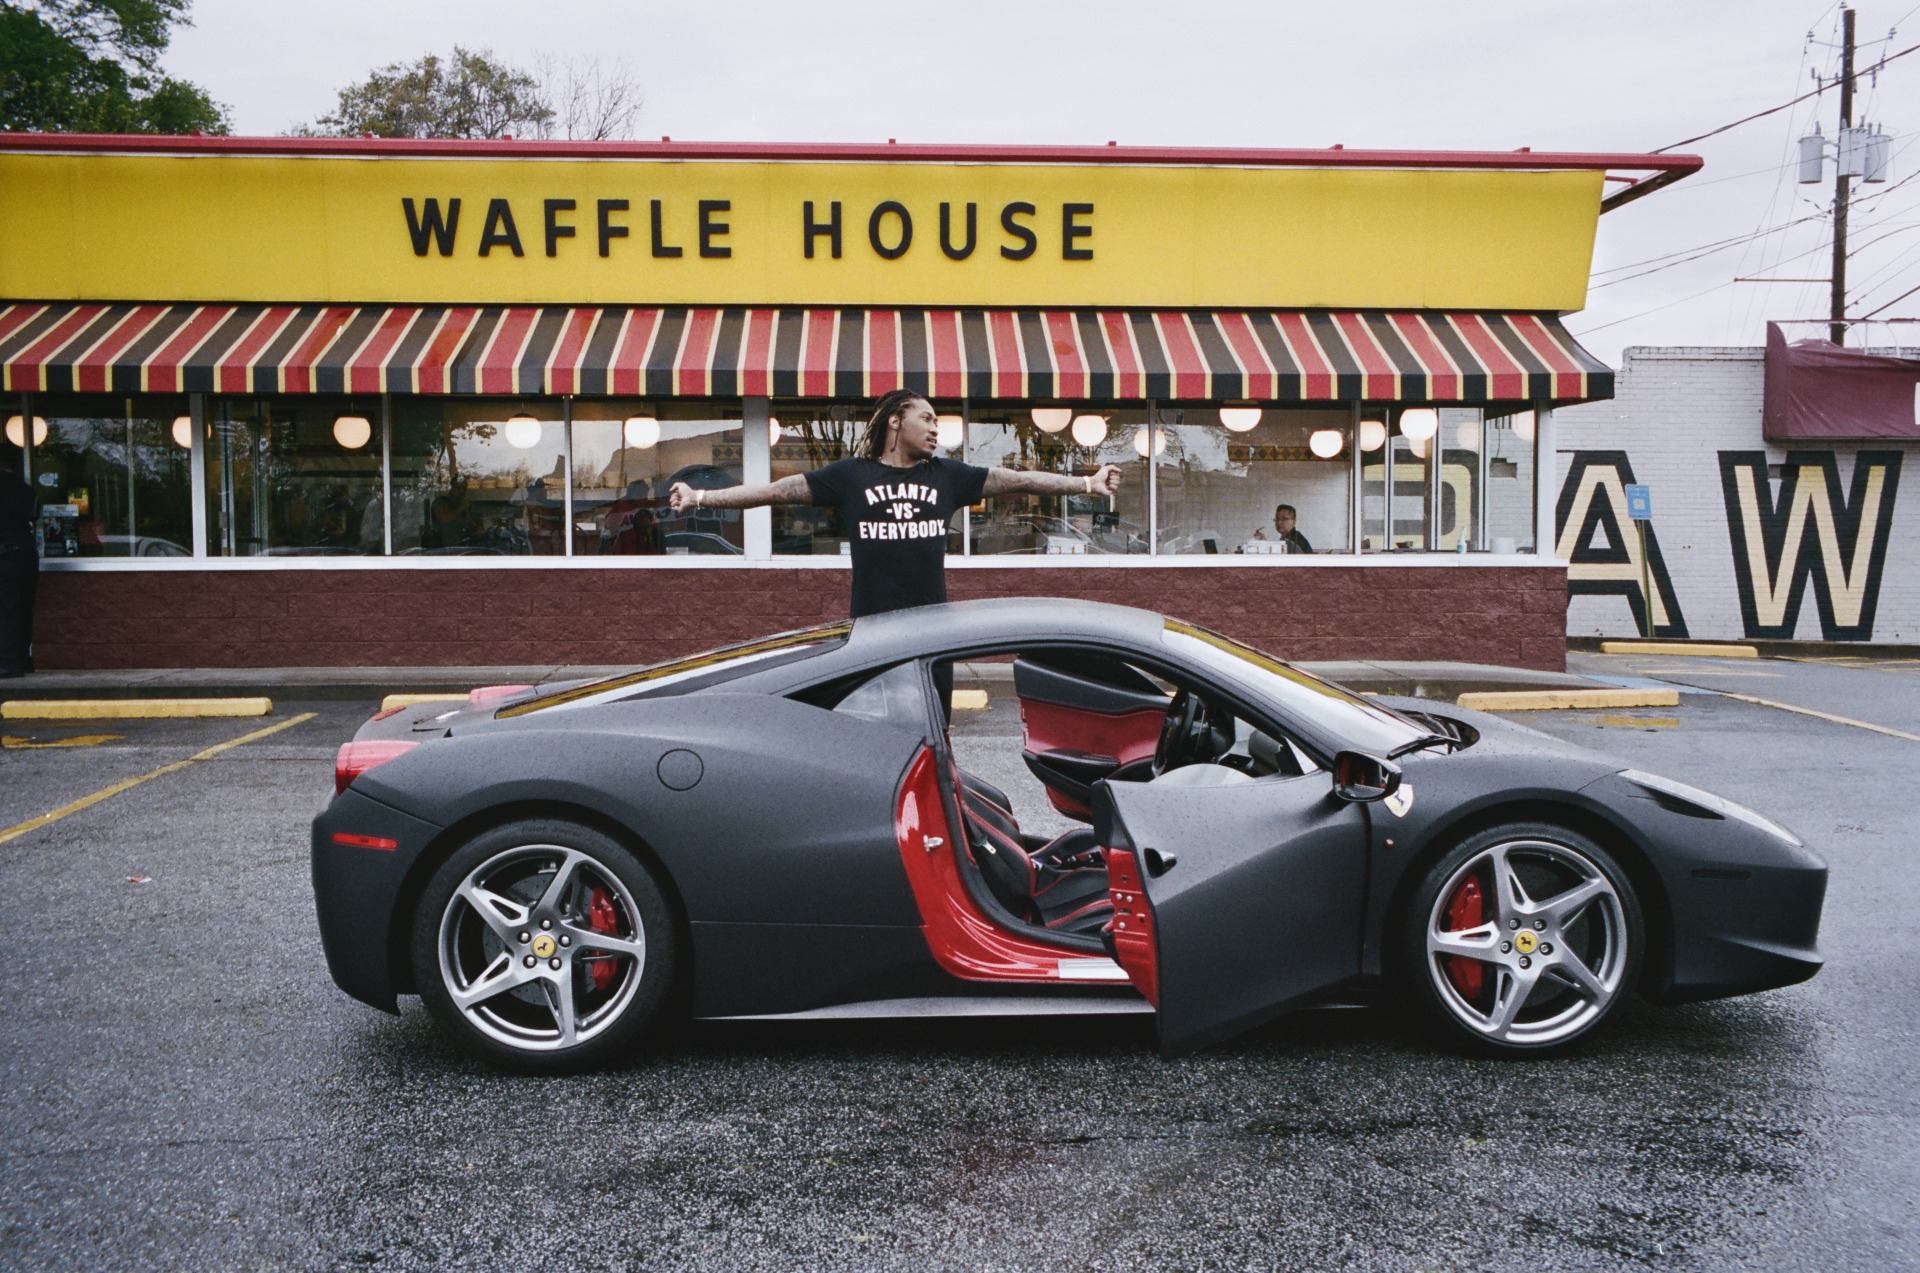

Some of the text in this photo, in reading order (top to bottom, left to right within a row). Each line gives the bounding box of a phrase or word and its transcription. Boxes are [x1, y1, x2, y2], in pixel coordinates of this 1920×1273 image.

[402, 197, 1095, 262] WAFFLE HOUSE
[864, 482, 938, 506] ATLANTA
